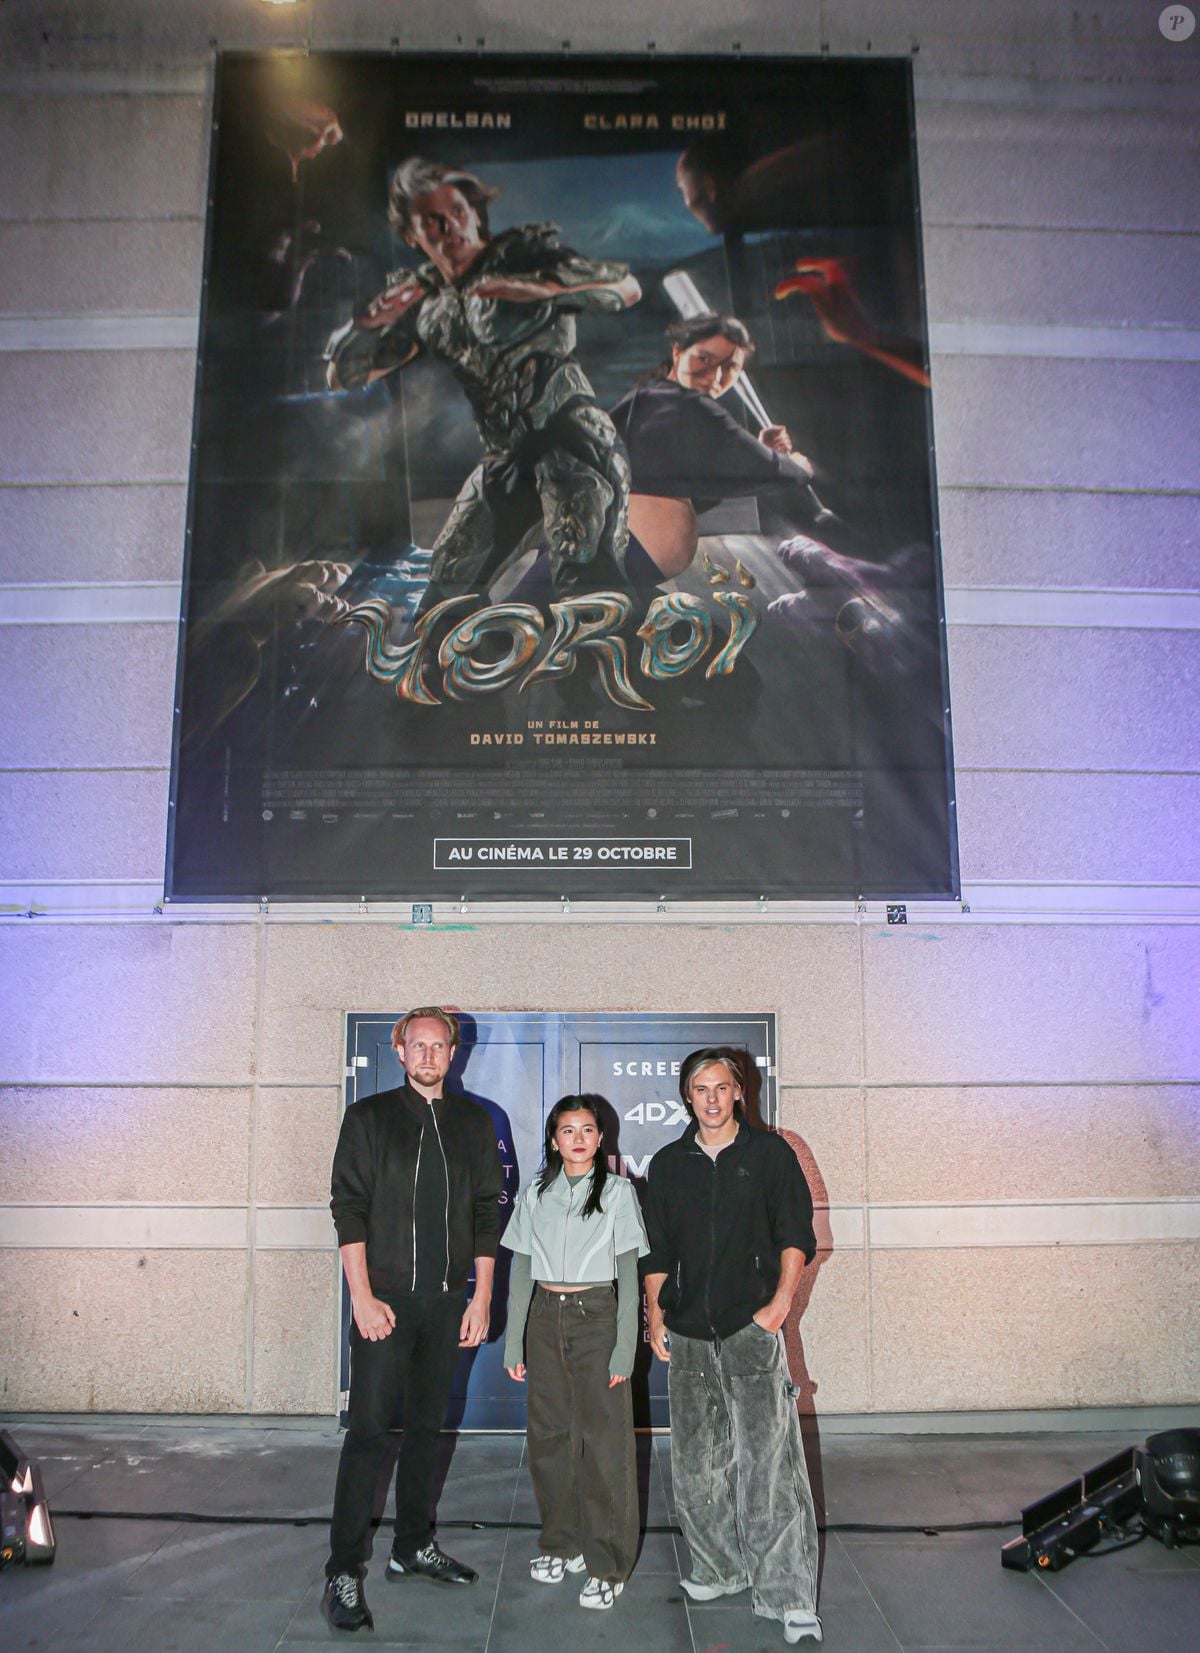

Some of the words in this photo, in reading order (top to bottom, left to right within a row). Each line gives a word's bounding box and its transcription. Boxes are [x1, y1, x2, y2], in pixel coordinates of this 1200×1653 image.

[584, 113, 659, 130] CLARA
[672, 111, 726, 130] CHOÏ
[527, 720, 543, 729] UN
[549, 720, 579, 729] FILM
[584, 720, 599, 729] DE
[470, 733, 524, 745] DAVID
[533, 733, 657, 745] TOMASZEWSKI
[448, 847, 473, 860] AU
[477, 844, 544, 860] CINÉMA
[549, 847, 569, 860] LE
[573, 847, 593, 860] 29
[597, 847, 677, 860] OCTOBRE
[613, 1062, 681, 1076] SCREE
[624, 1100, 693, 1126] 4DX
